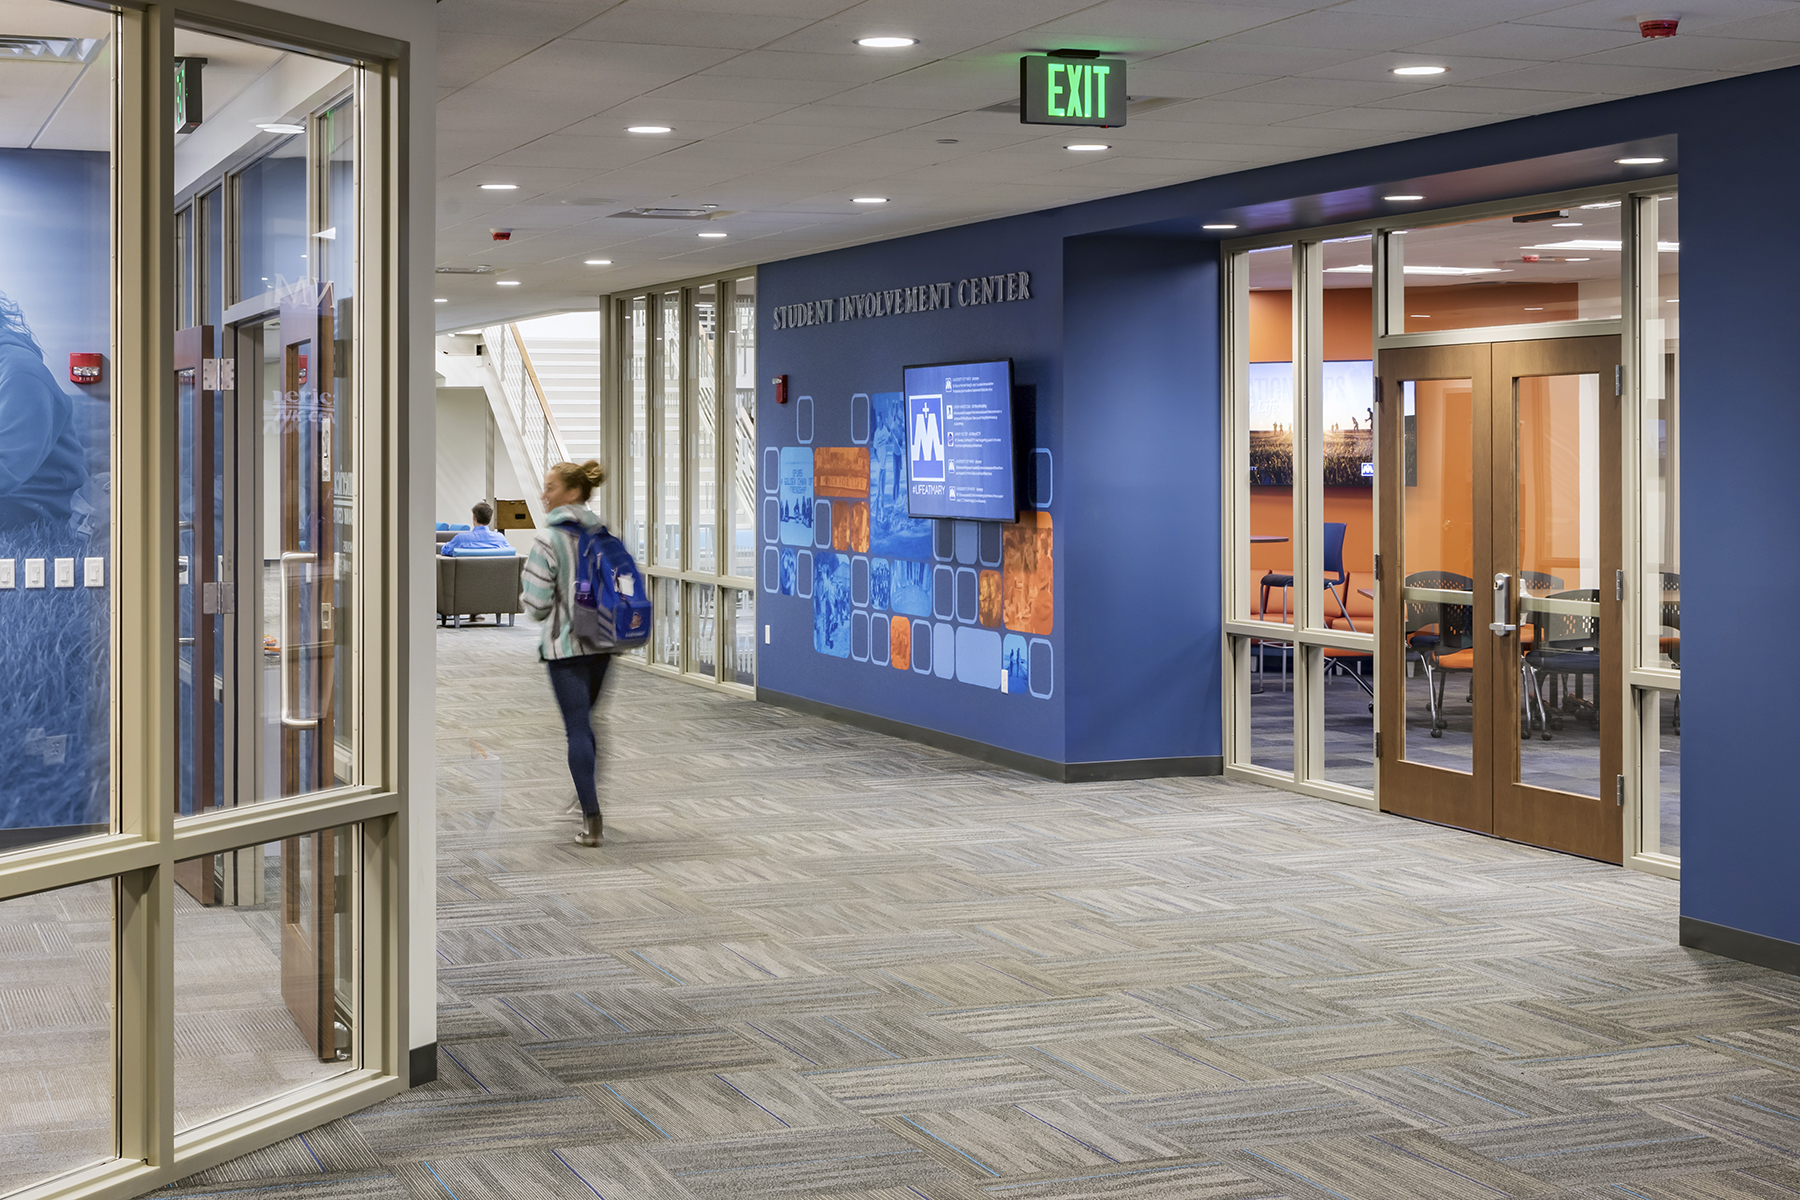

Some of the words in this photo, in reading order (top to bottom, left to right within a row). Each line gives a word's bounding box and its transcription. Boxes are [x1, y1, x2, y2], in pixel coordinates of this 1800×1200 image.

[1048, 63, 1110, 119] EXIT
[773, 299, 834, 331] STUDENT
[839, 281, 952, 322] INVOLVEMENT
[957, 271, 1031, 307] CENTER
[912, 484, 946, 495] #LIFEATMARY
